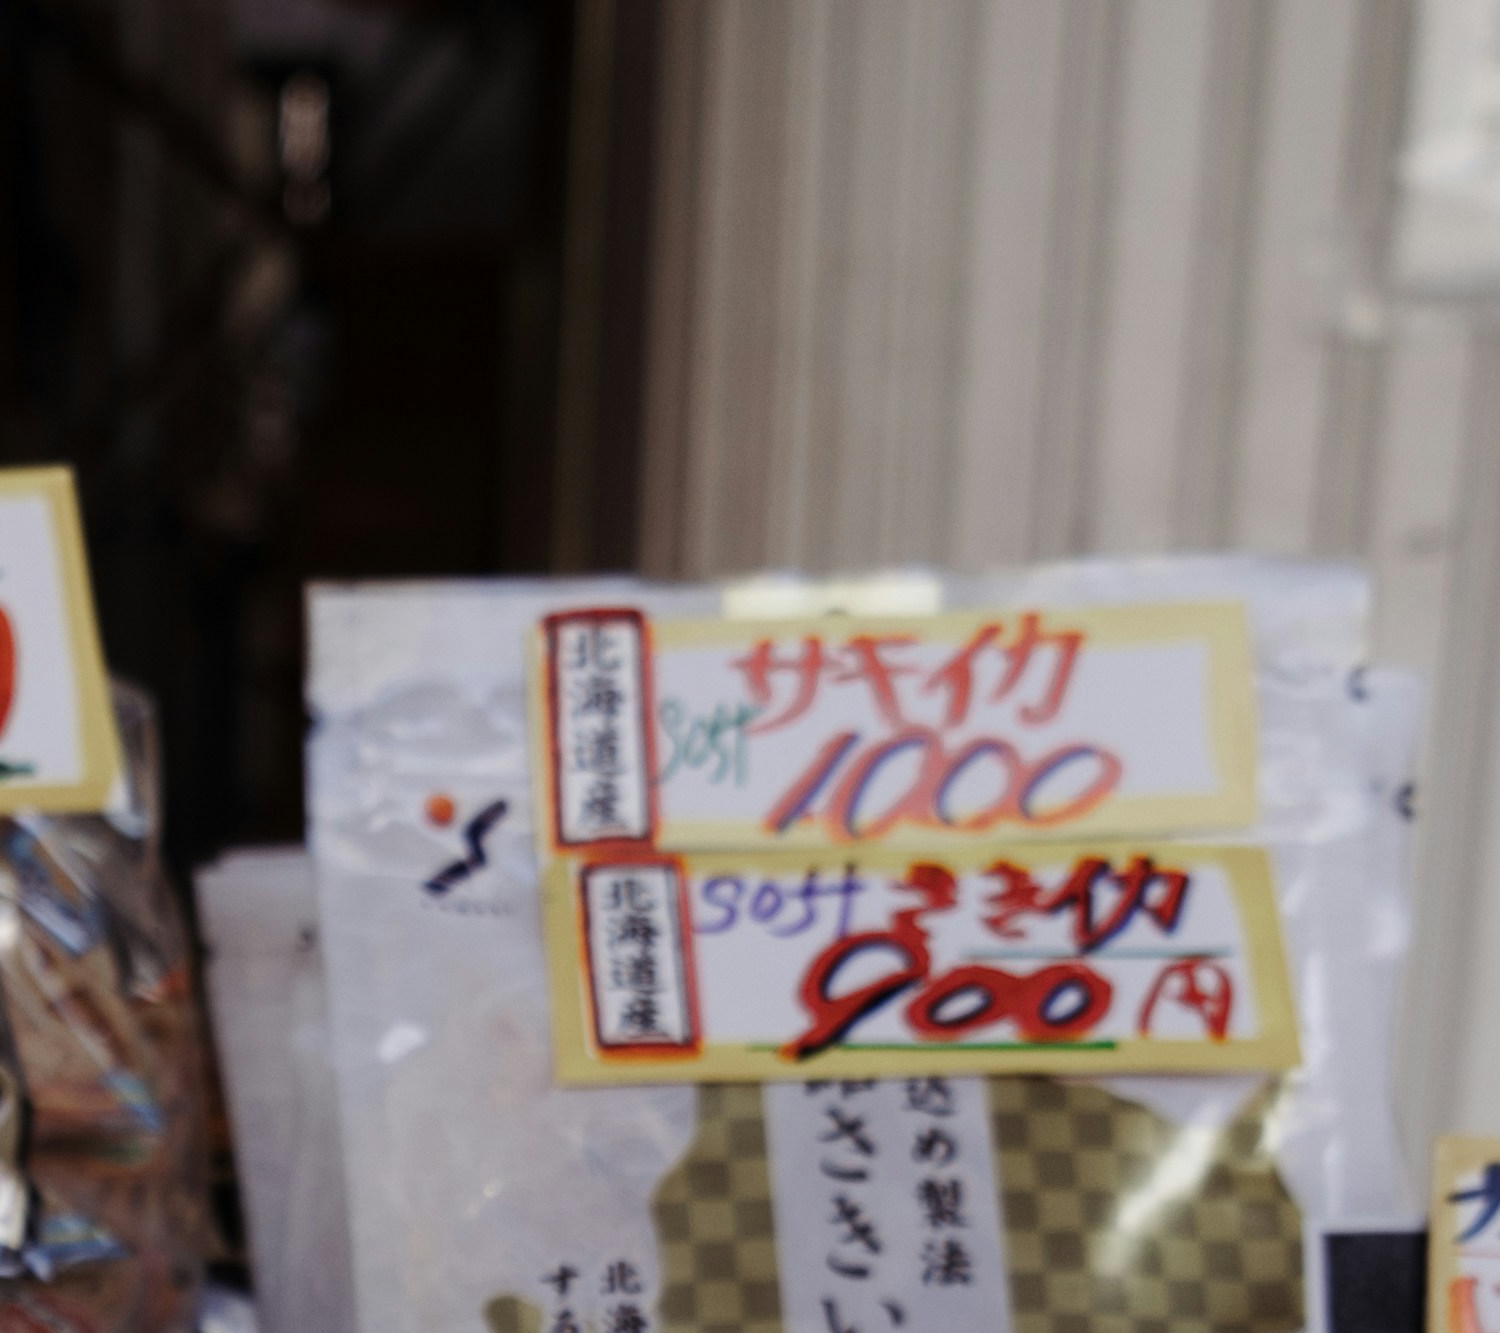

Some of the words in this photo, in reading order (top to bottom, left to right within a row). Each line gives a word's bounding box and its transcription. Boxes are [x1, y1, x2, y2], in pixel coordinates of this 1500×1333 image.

[730, 613, 1085, 734] サキイカ
[760, 722, 1124, 842] 1000
[605, 868, 665, 1042] 北海道産
